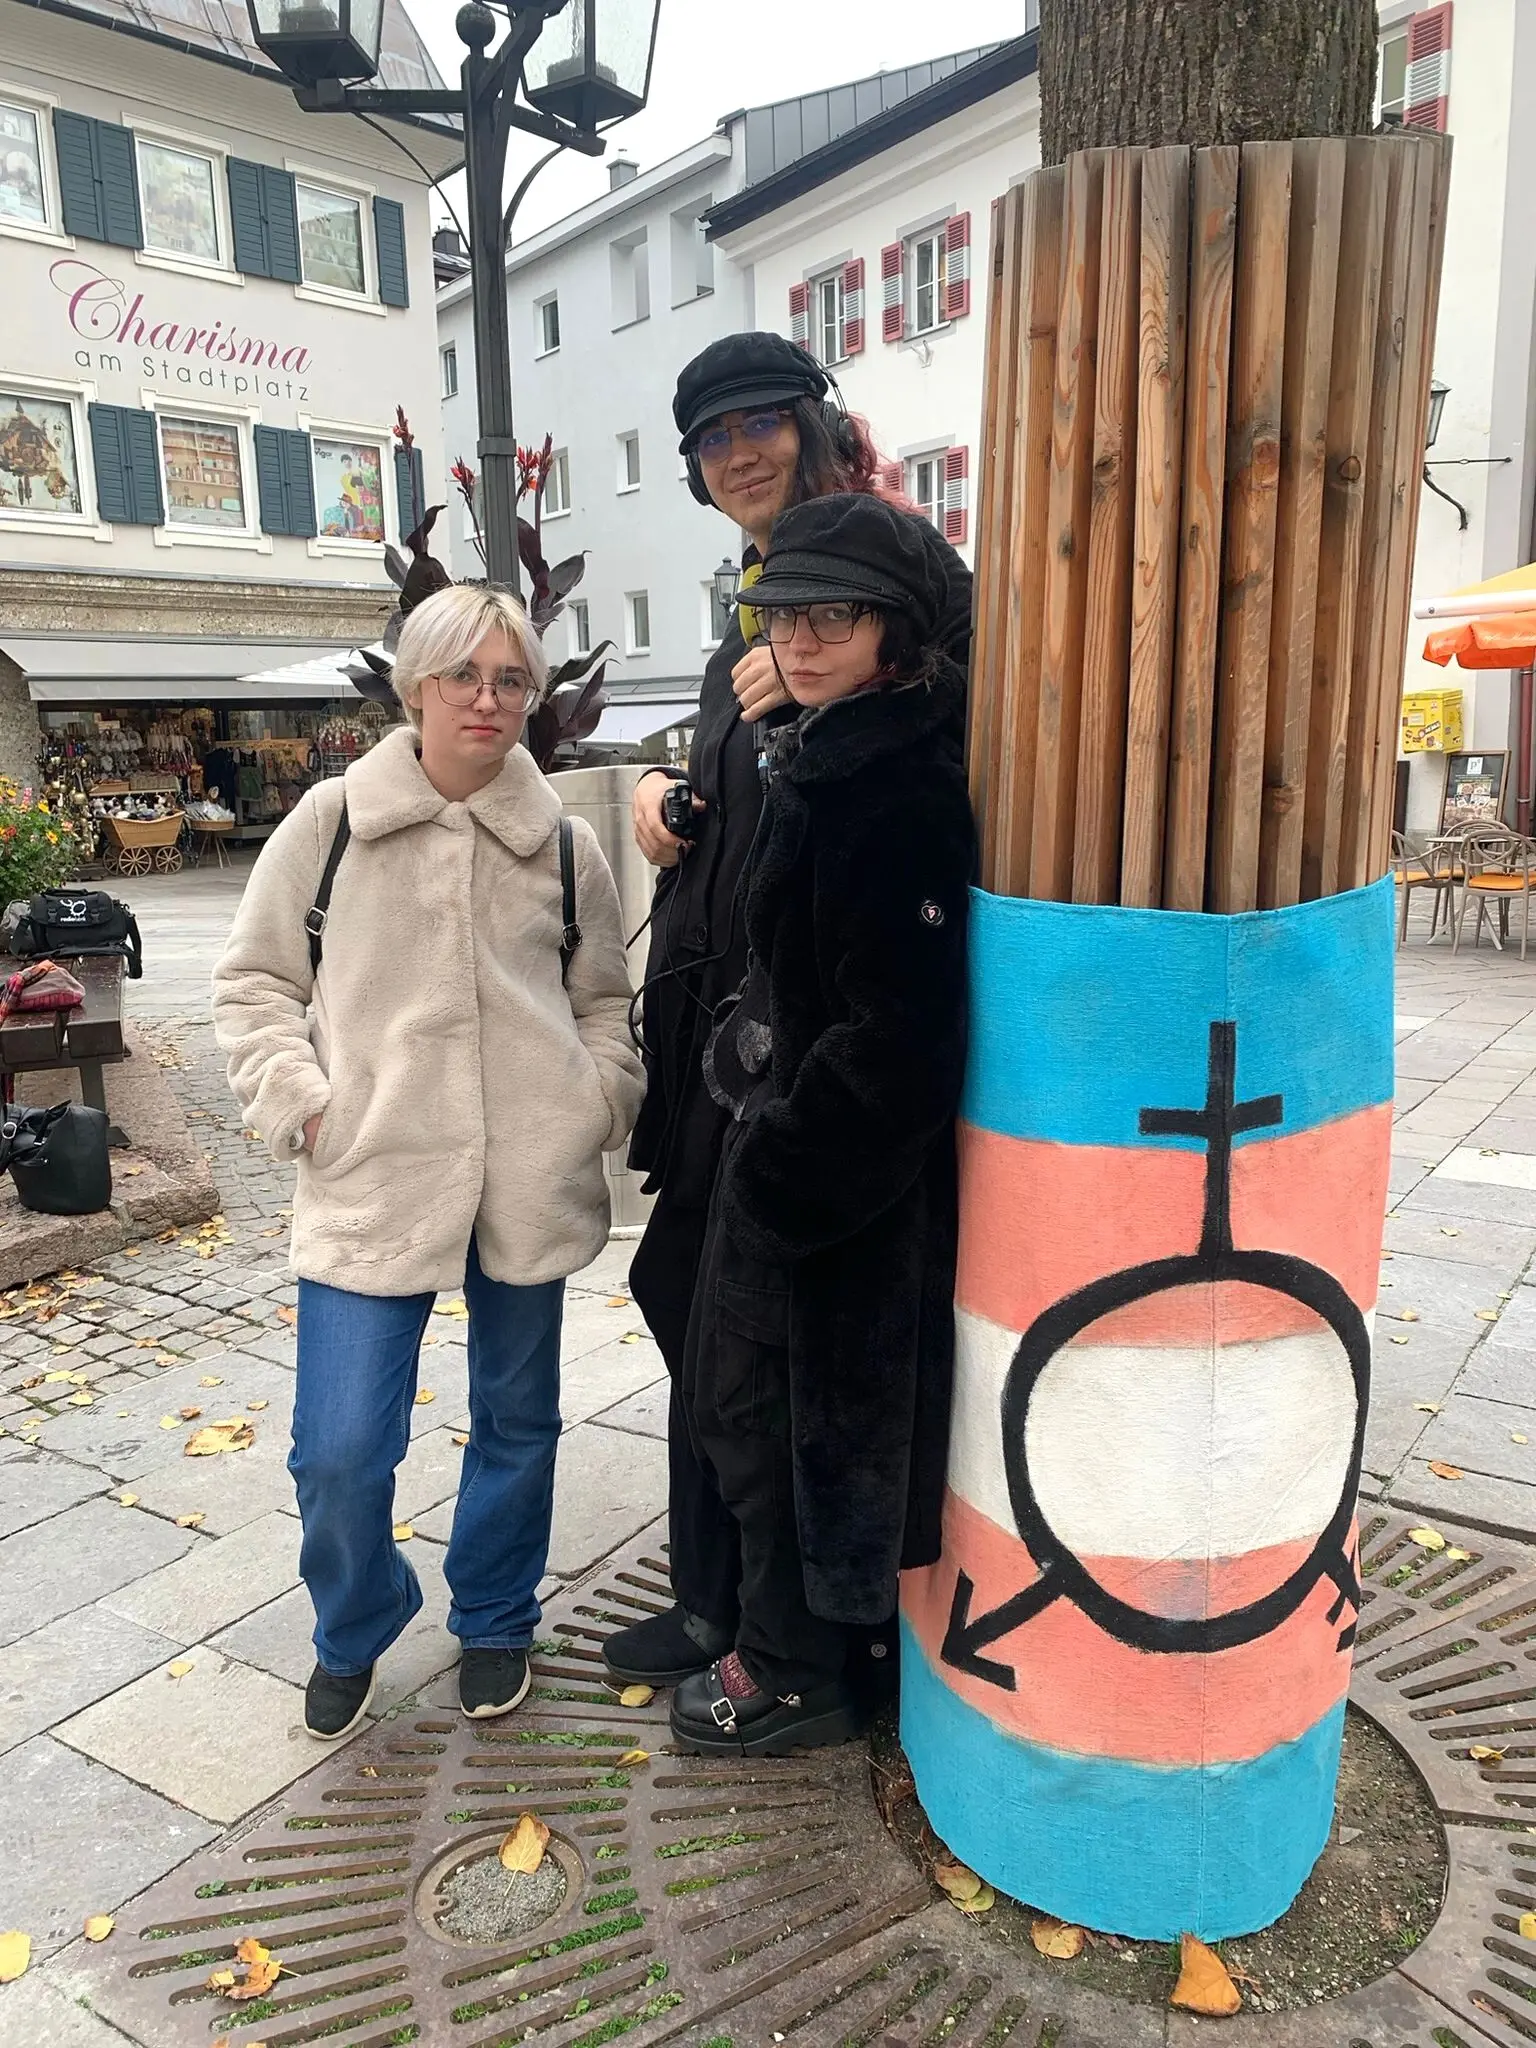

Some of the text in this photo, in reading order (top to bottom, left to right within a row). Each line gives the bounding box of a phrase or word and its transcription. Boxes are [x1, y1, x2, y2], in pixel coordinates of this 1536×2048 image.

[49, 259, 312, 374] Charisma
[75, 350, 309, 401] am Stadtplatz
